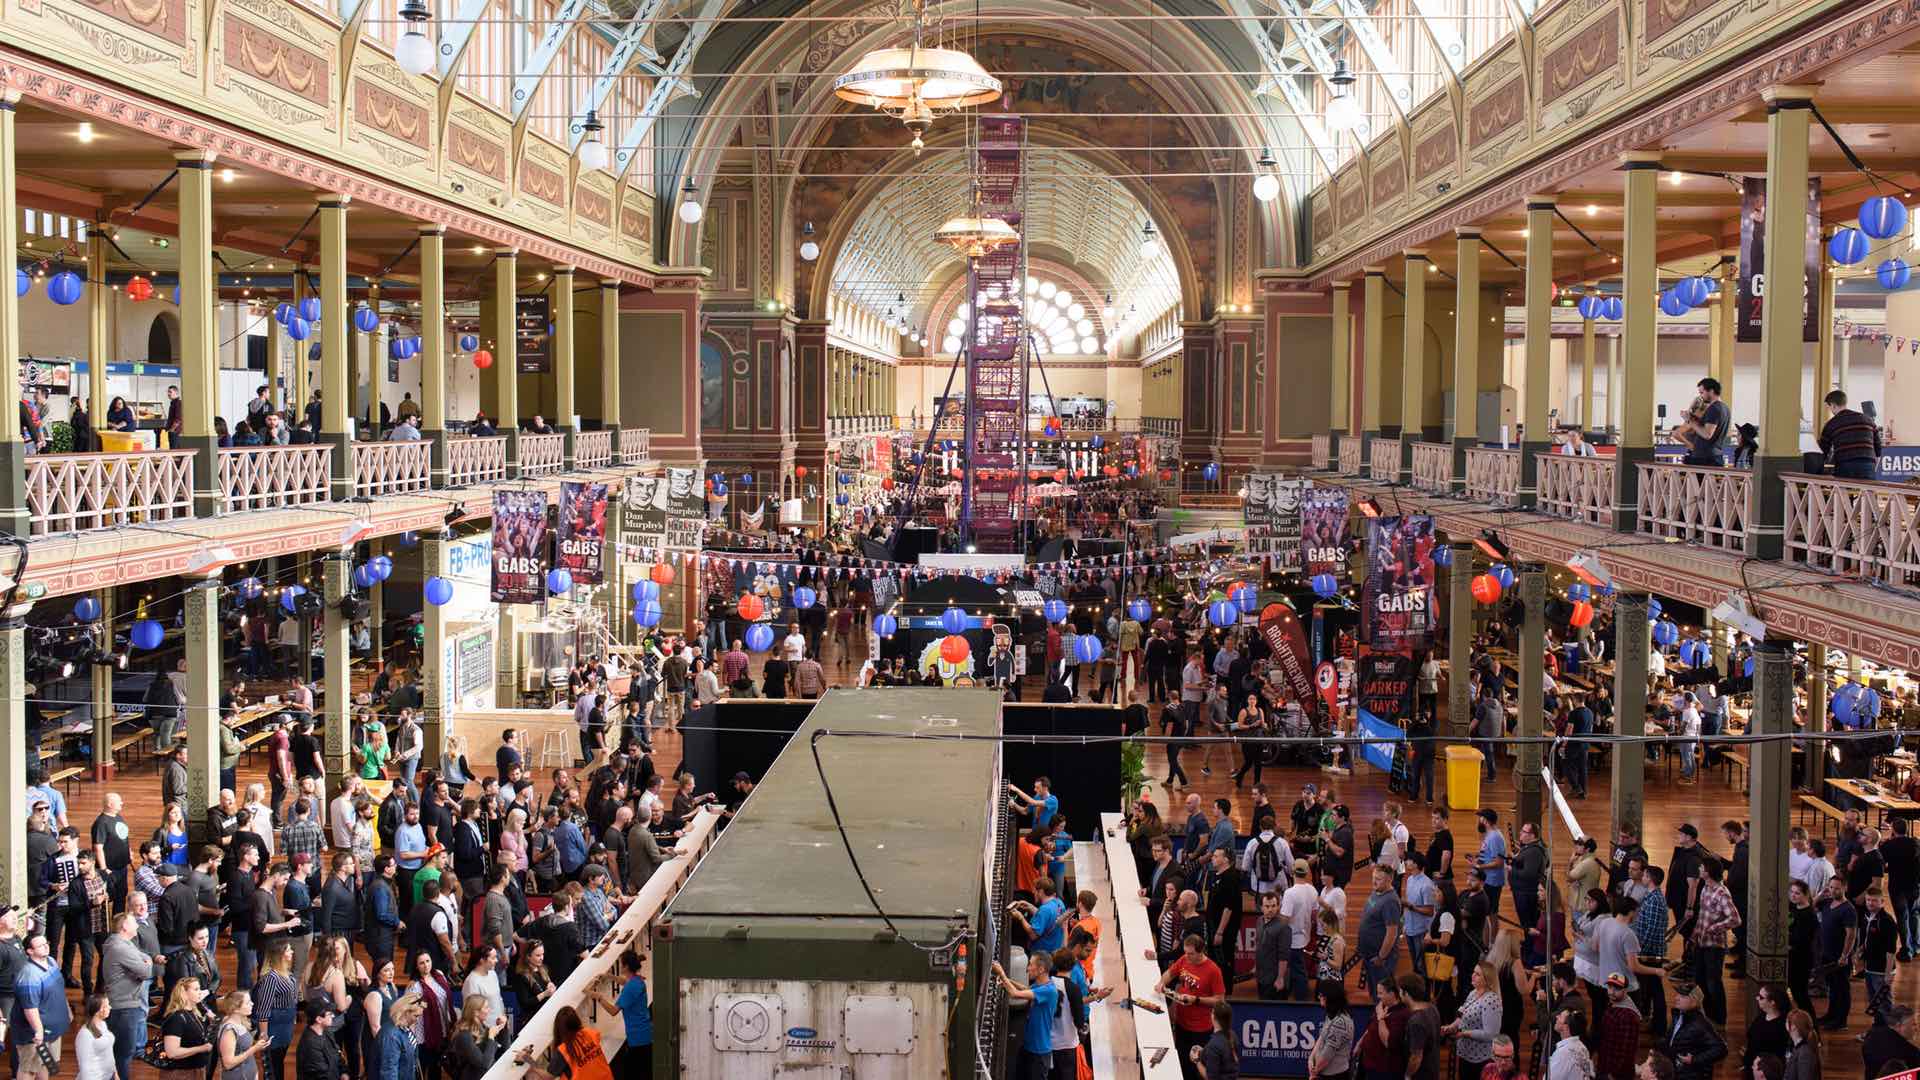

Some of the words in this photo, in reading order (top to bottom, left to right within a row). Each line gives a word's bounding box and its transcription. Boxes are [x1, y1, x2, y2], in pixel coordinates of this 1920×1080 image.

[625, 511, 643, 520] Dan
[625, 519, 663, 531] Murphy's
[626, 535, 659, 547] MARKET
[667, 532, 697, 546] PLACE
[562, 540, 599, 556] GABS
[1308, 547, 1345, 562] GABS
[498, 557, 539, 574] GABS
[1378, 591, 1425, 612] GABS
[1370, 699, 1399, 713] DAYS
[1242, 1019, 1316, 1050] GABS
